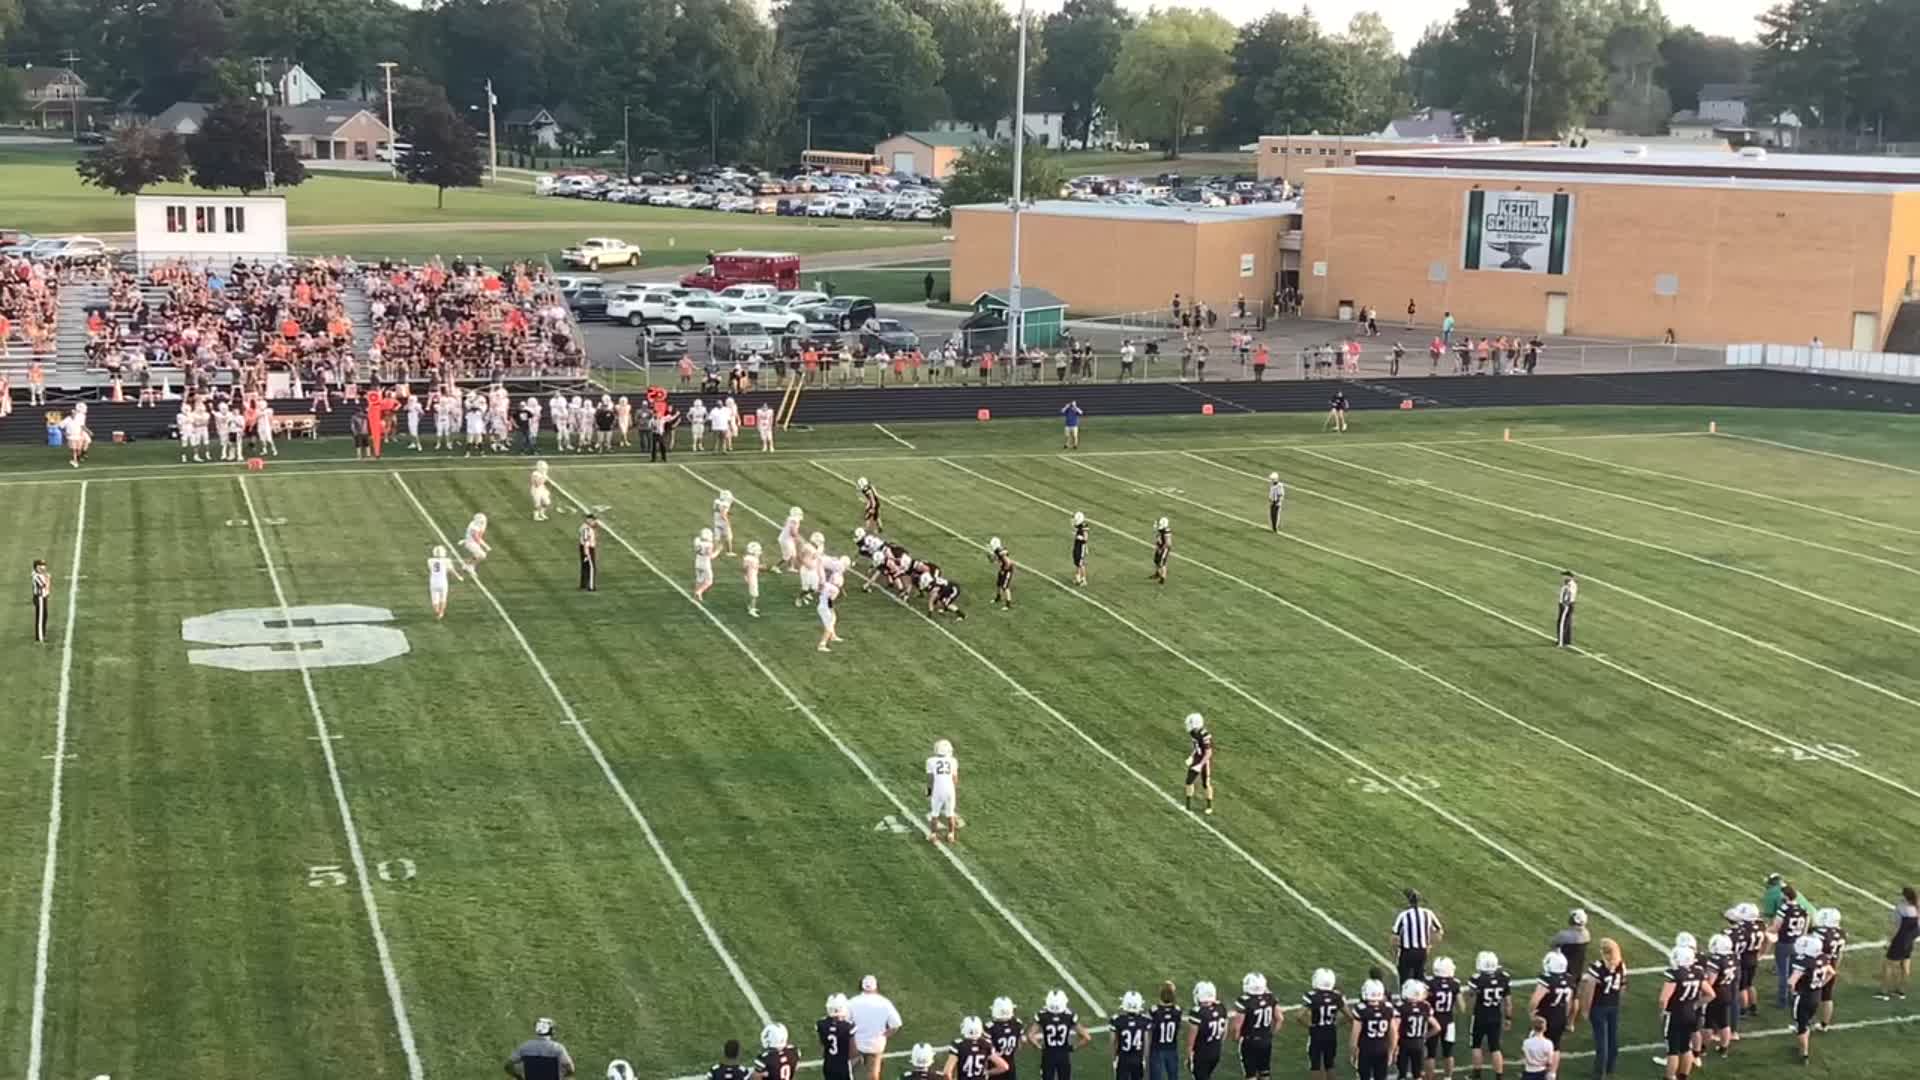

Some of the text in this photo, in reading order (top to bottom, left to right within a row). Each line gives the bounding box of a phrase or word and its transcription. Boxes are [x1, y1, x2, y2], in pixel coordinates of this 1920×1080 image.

[1498, 200, 1538, 217] KEITH
[1487, 214, 1549, 234] SCHROCK
[181, 603, 411, 672] S
[936, 760, 951, 775] 23
[1603, 973, 1622, 995] 74
[1679, 979, 1701, 1002] 77
[1435, 991, 1454, 1013] 21
[1483, 988, 1505, 1008] 55
[1253, 1006, 1273, 1029] 70
[1319, 1005, 1338, 1026] 15
[1406, 1015, 1425, 1038] 31
[1045, 1024, 1068, 1047] 23
[1159, 1021, 1176, 1044] 10
[1367, 1020, 1389, 1038] 59
[826, 1034, 838, 1056] 3
[1121, 1029, 1143, 1052] 34
[962, 1055, 986, 1078] 45
